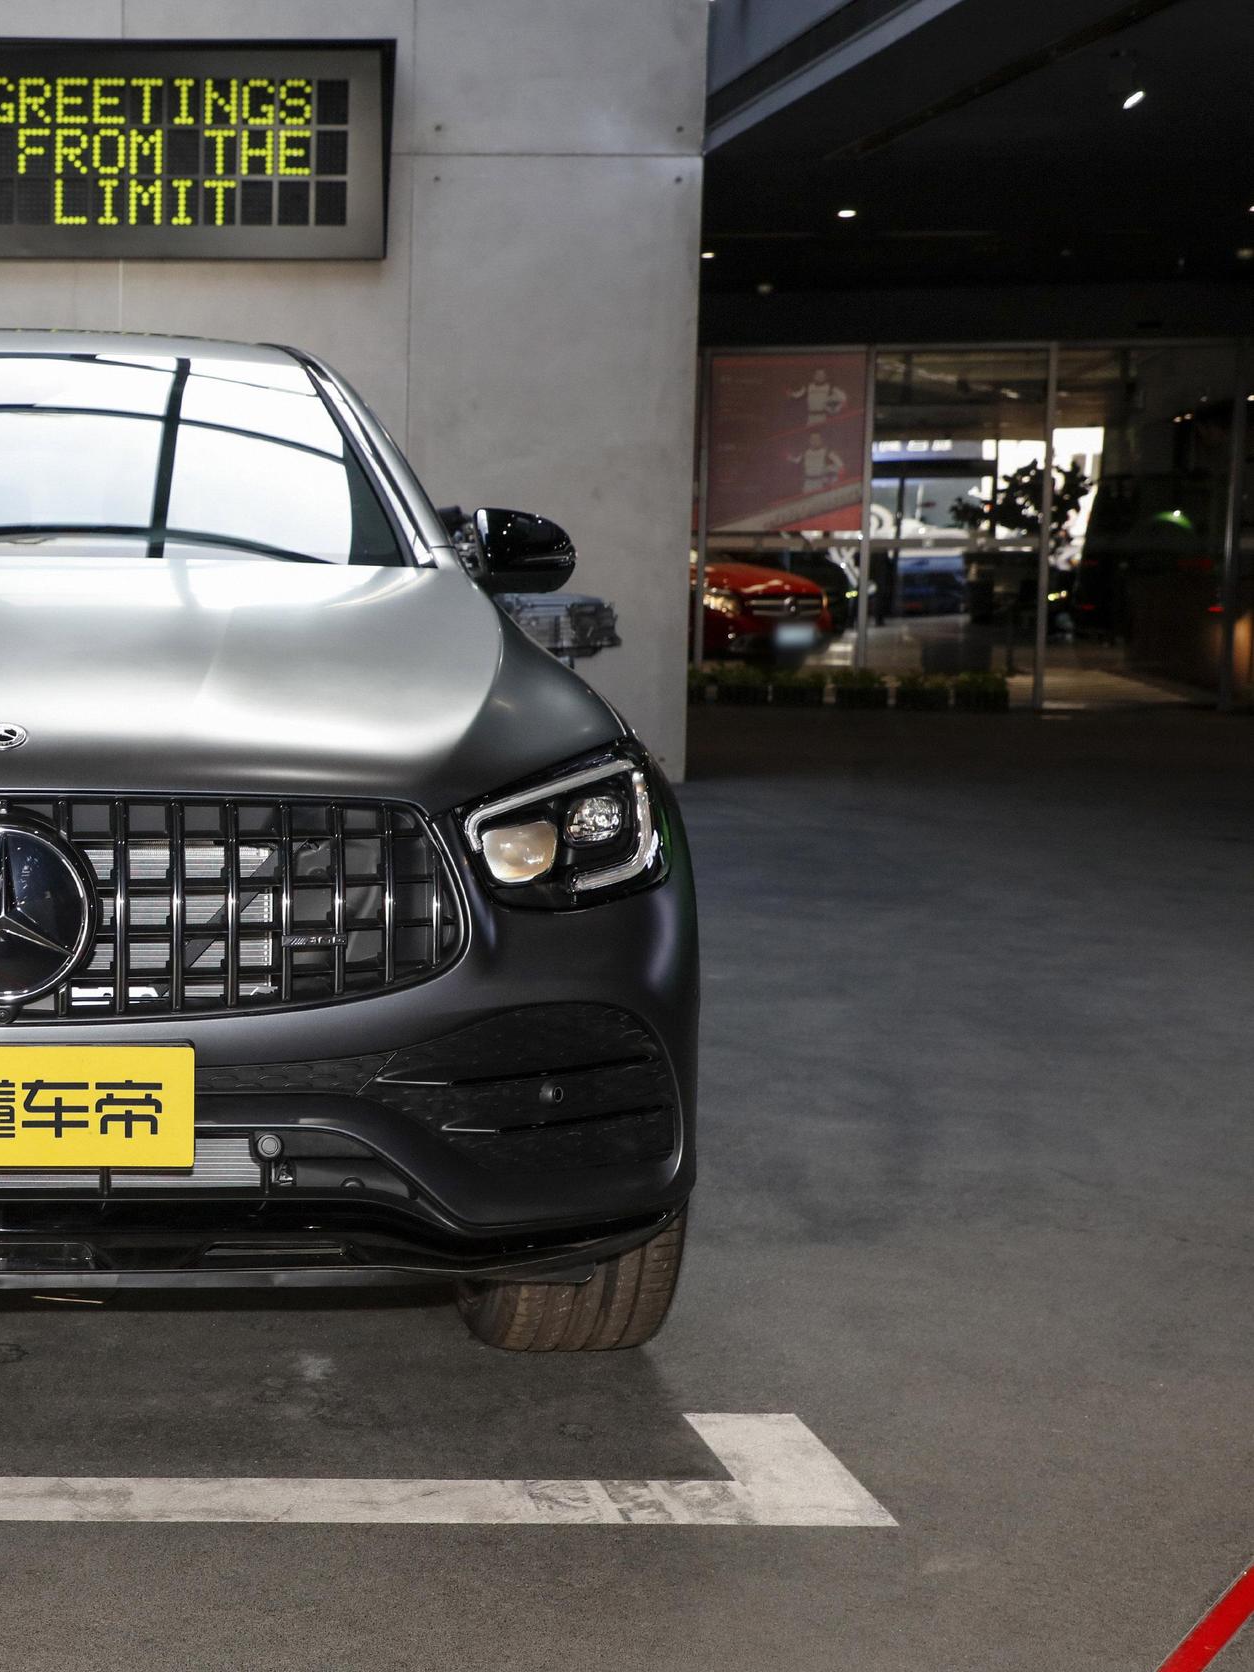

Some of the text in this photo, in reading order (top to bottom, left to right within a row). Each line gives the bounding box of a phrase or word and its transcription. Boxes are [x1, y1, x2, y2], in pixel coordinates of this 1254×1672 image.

[17, 128, 312, 176] FROM THE
[54, 178, 237, 225] LIMIT
